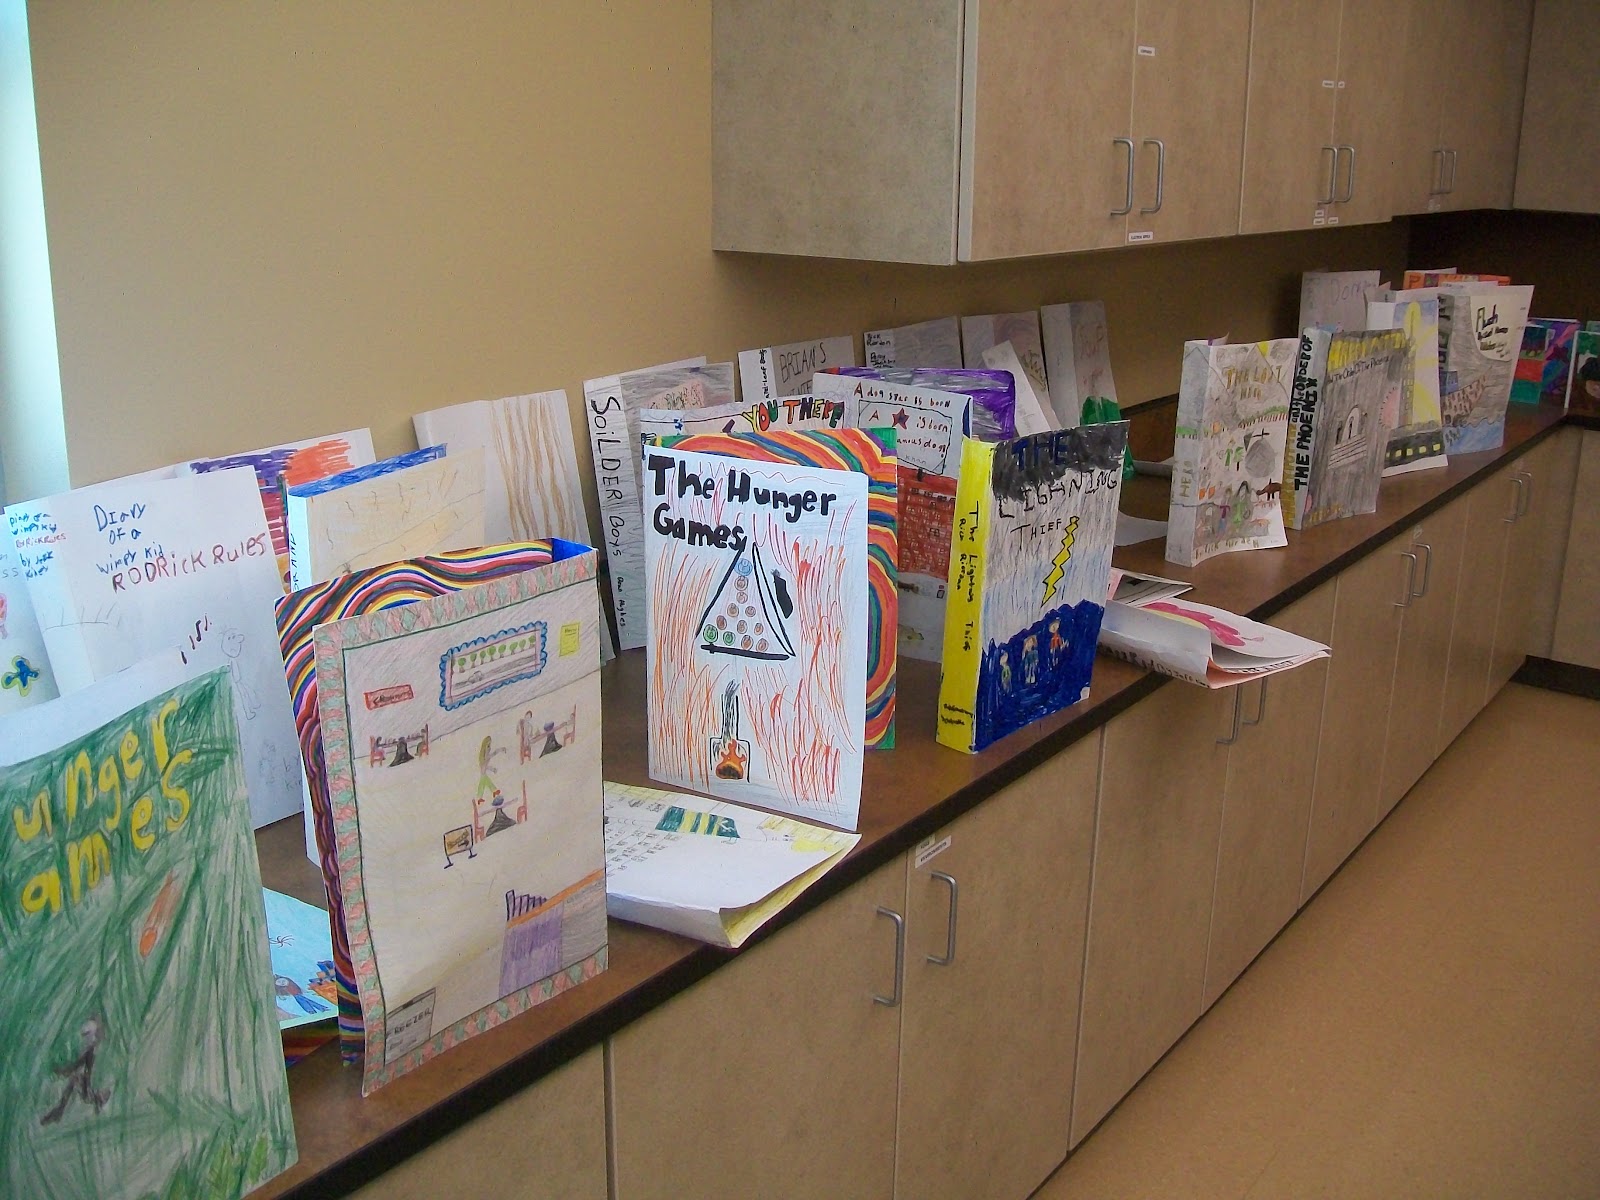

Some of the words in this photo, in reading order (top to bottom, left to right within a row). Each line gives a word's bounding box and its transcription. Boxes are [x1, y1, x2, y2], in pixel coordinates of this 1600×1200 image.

[853, 381, 864, 399] A
[868, 410, 879, 421] A
[648, 453, 715, 499] The
[728, 466, 836, 523] Hunger
[1293, 454, 1309, 491] THE
[131, 528, 142, 540] a
[653, 503, 747, 552] Games
[12, 698, 179, 842] unger
[21, 748, 193, 914] ames
